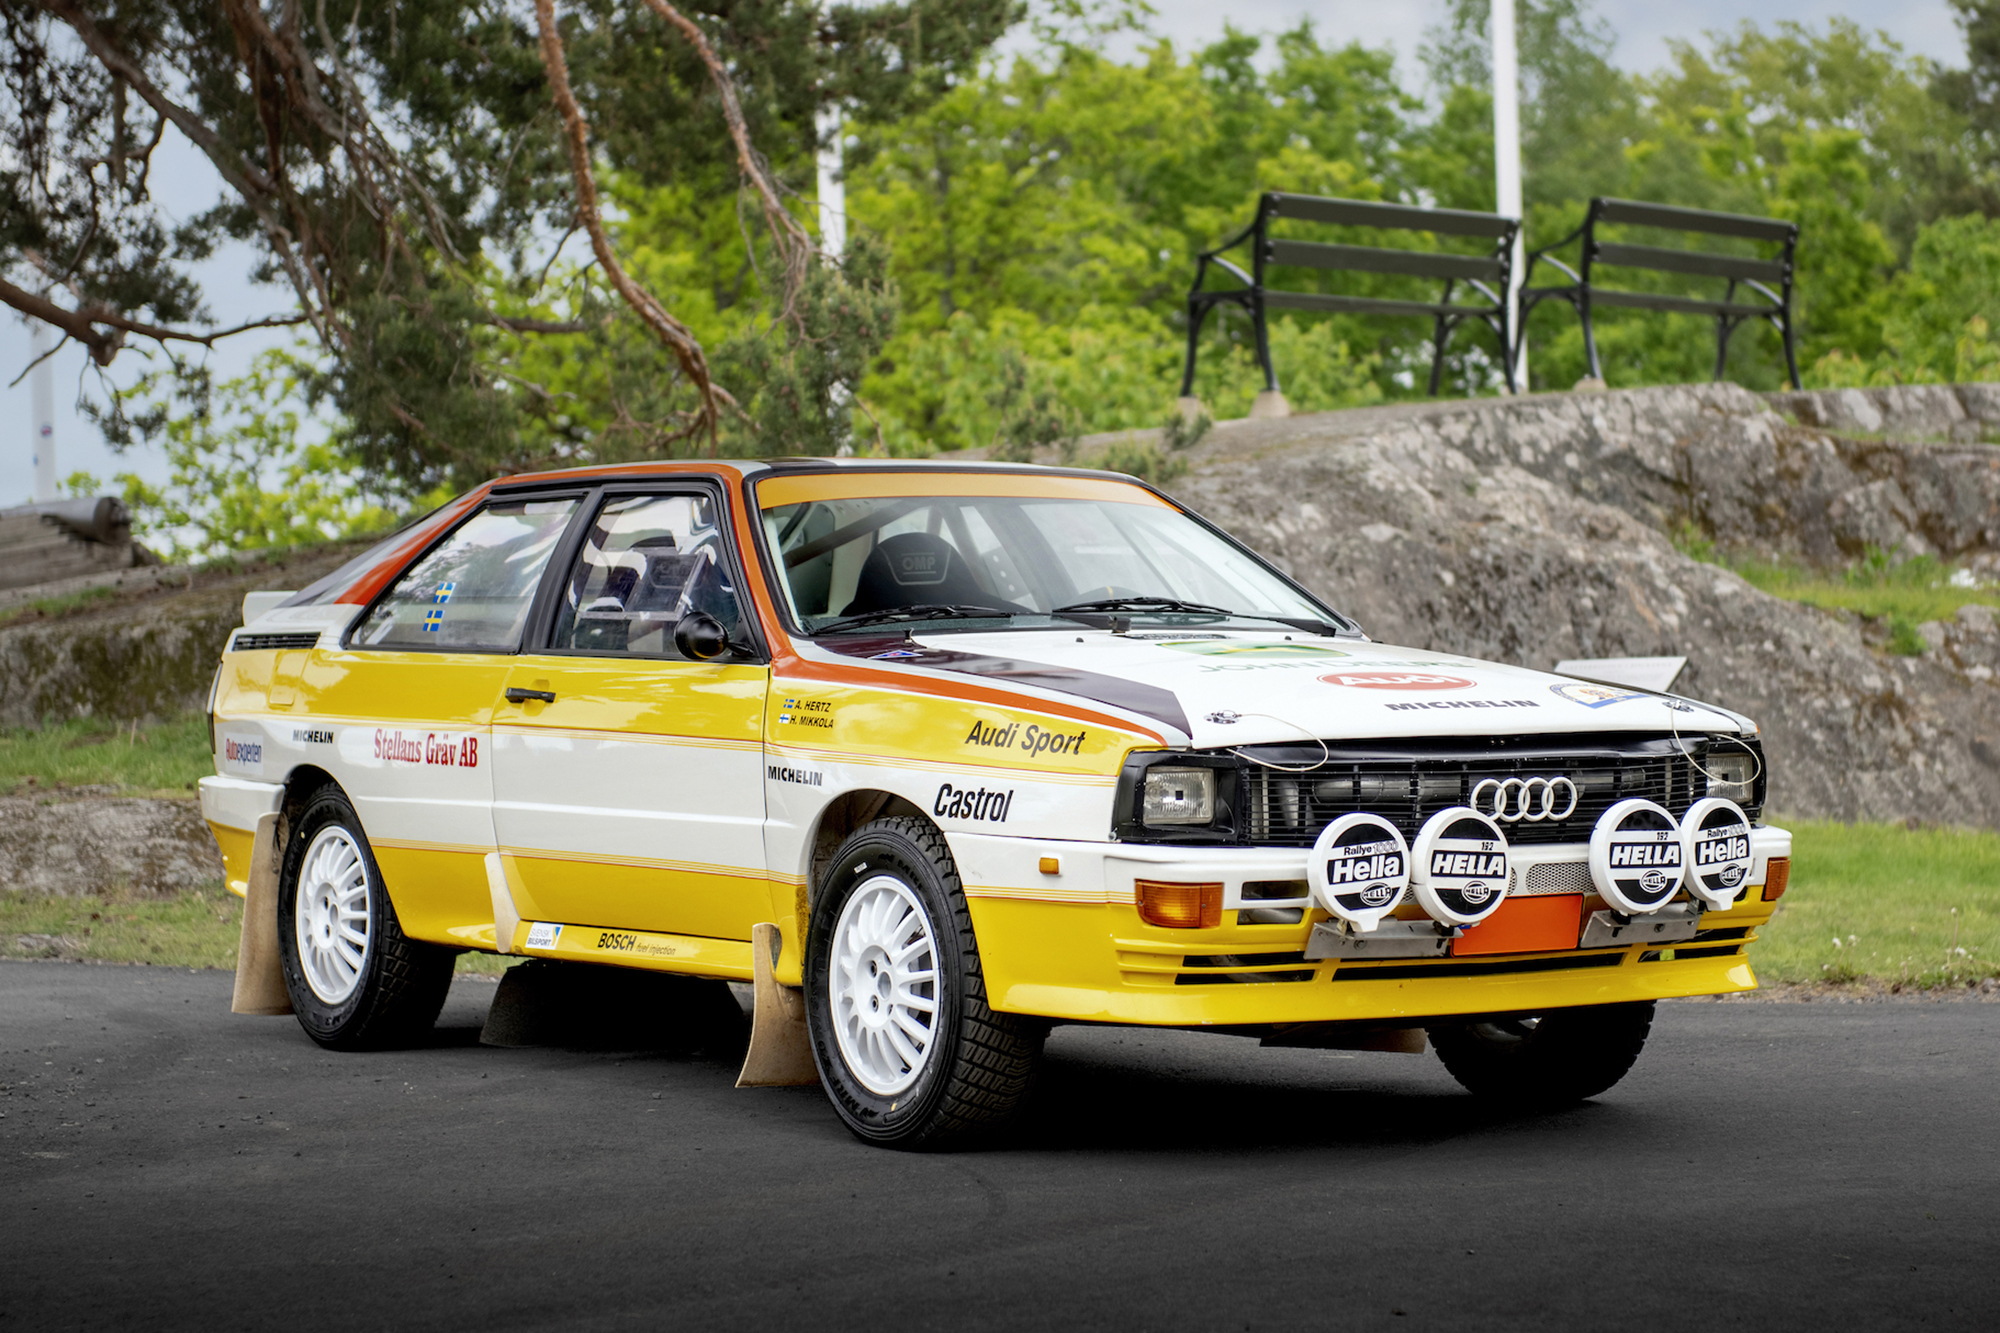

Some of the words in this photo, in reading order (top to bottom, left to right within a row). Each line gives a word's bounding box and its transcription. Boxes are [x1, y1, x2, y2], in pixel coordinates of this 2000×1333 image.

[902, 555, 936, 571] OMP
[804, 700, 832, 713] HERTZ
[1384, 700, 1541, 711] MICHELIN
[798, 715, 834, 729] MIKKOLA
[293, 729, 335, 744] MICHELIN
[965, 720, 1020, 748] Audi
[1020, 724, 1086, 757] Sport
[225, 737, 263, 766] Autoexperten
[374, 728, 421, 763] Stellans
[426, 733, 457, 767] Gräv
[459, 737, 479, 768] AB
[768, 766, 823, 787] MICHELIN
[934, 783, 1014, 823] Castrol
[1707, 829, 1727, 839] Rallye
[1343, 845, 1372, 857] Rallye
[1611, 845, 1680, 865] HELLA
[1700, 837, 1748, 865] Hella
[1332, 856, 1400, 884] Hella
[1432, 853, 1504, 876] HELLA
[1643, 876, 1665, 885] HELLA
[1721, 868, 1742, 879] HELLA
[1363, 887, 1392, 899] HELLA
[1465, 887, 1489, 896] HELLA
[527, 937, 551, 947] BILSPORT
[597, 932, 637, 952] BOSCH
[635, 943, 648, 953] fuel
[649, 944, 676, 957] injection
